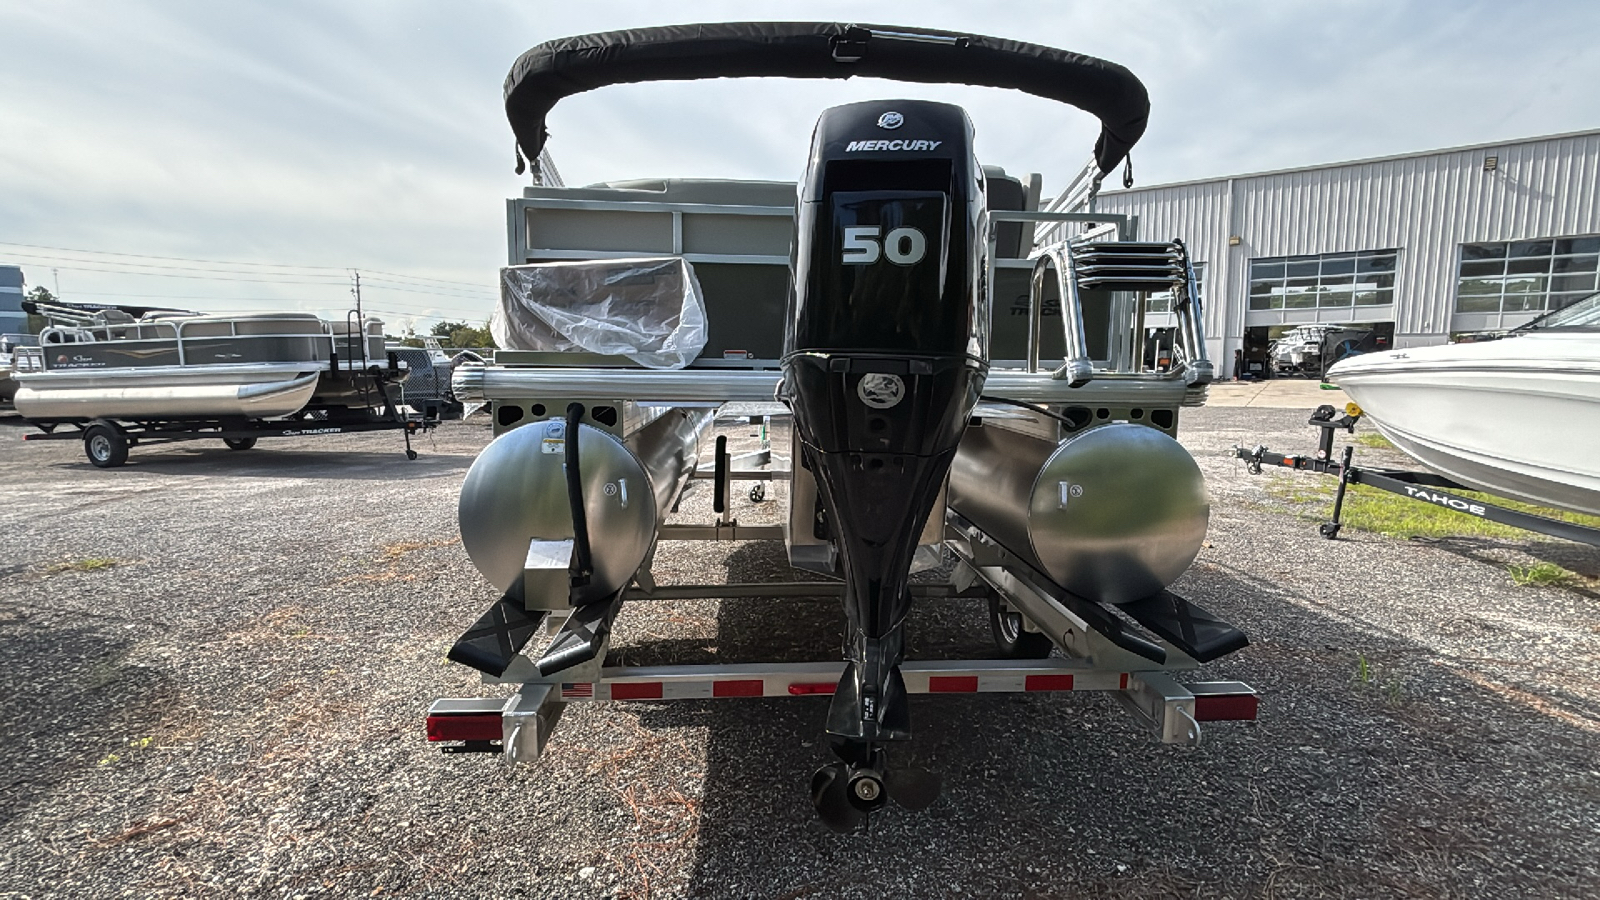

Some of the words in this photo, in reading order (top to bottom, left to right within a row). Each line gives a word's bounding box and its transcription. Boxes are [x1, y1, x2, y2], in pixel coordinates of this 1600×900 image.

[845, 139, 942, 152] MERCURY
[842, 226, 927, 266] 50
[1404, 486, 1486, 516] TAHOE
